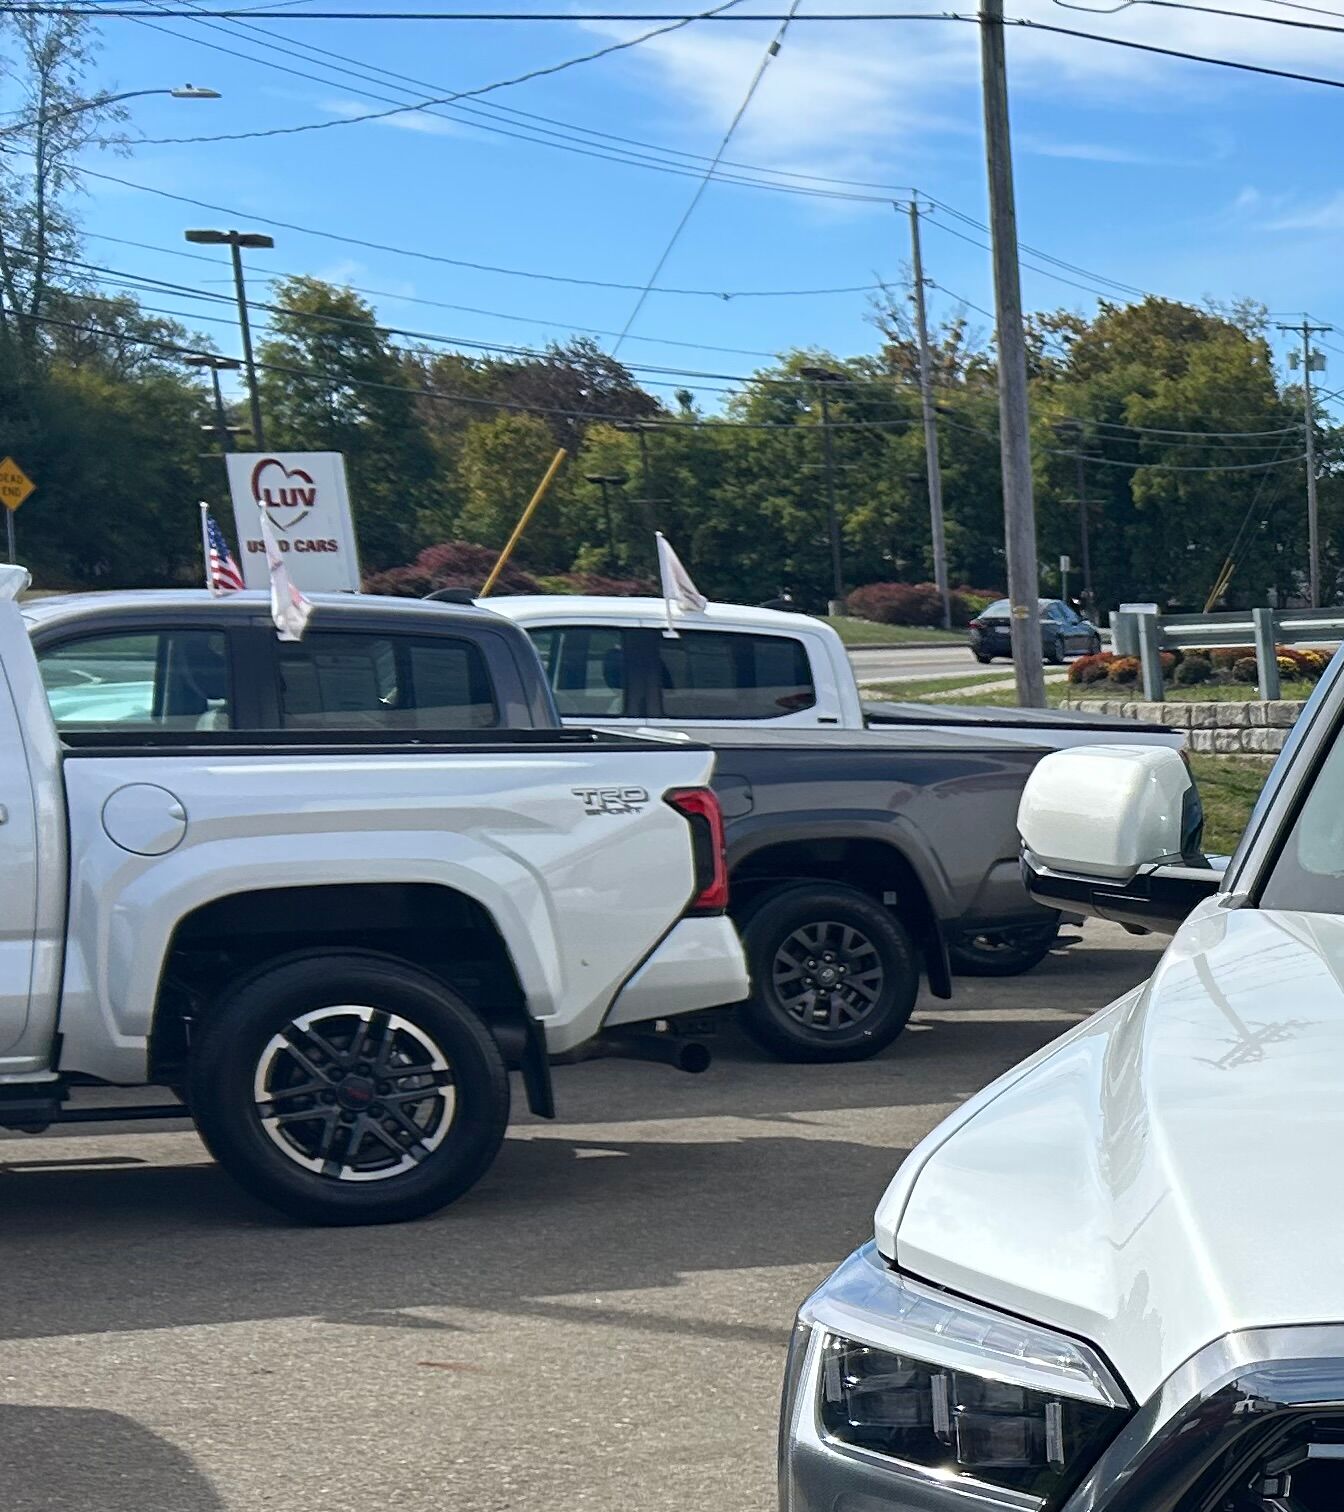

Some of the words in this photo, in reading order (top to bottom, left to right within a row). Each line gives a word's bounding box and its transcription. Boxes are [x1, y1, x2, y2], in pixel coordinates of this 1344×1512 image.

[264, 488, 317, 507] LUV
[247, 540, 290, 553] USD
[294, 540, 338, 553] CARS
[571, 786, 649, 808] TRD
